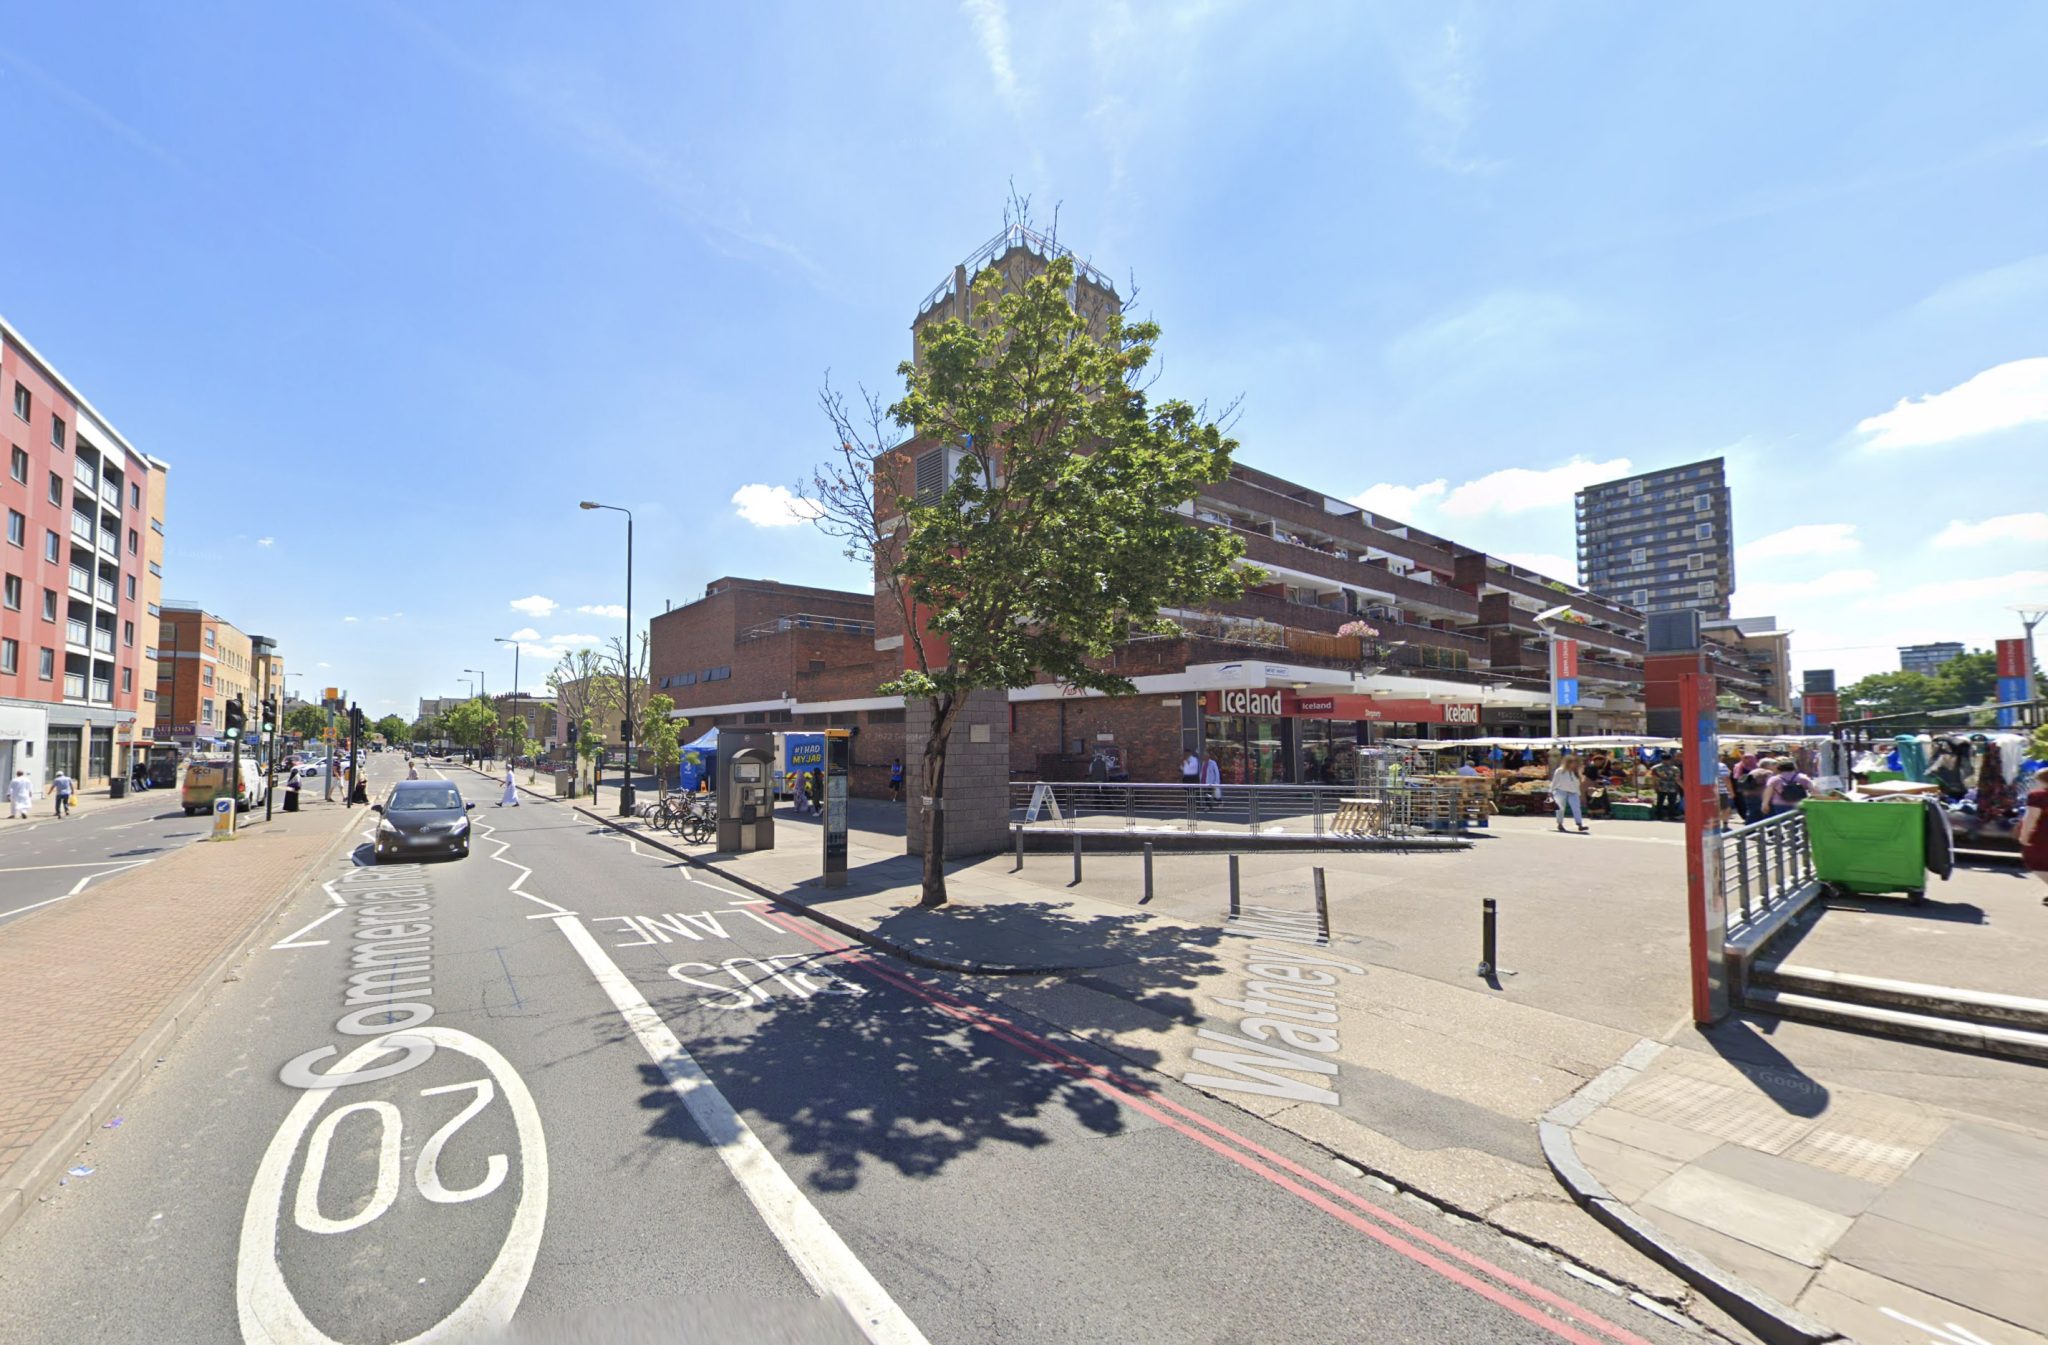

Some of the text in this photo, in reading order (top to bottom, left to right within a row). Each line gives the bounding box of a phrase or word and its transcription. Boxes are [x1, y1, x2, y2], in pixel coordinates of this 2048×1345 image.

[1221, 688, 1282, 715] Iceland
[1302, 702, 1332, 710] Iceland
[1444, 704, 1478, 722] Iceland
[792, 755, 806, 764] MY
[804, 745, 820, 753] HAD
[592, 908, 787, 948] LANE
[667, 953, 869, 1010] BUS
[295, 1078, 510, 1235] 20
